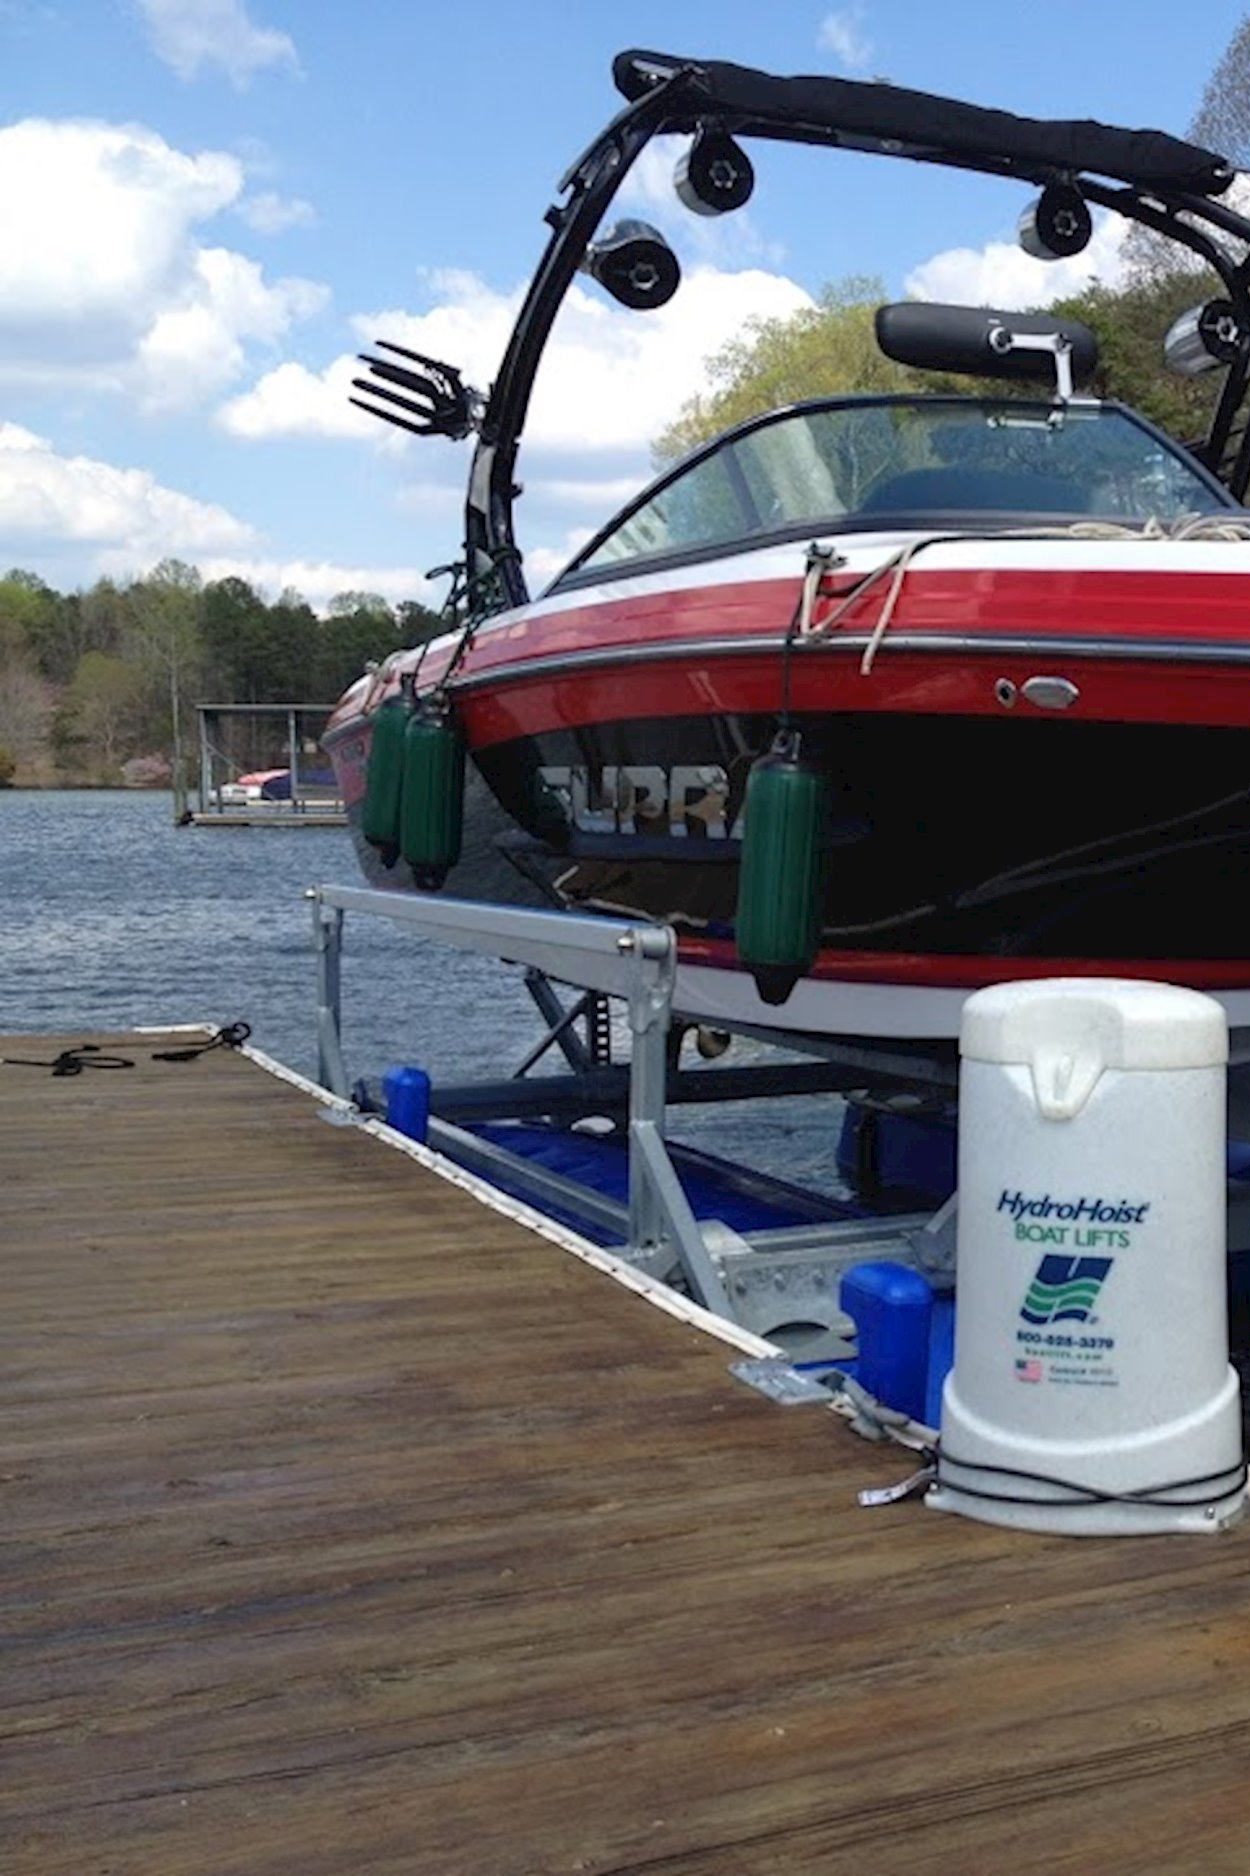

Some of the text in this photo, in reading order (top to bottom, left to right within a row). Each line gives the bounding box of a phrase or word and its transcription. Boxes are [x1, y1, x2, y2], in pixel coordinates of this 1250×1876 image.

[997, 1189, 1149, 1223] HydroHoist
[1015, 1222, 1130, 1248] BOAT LIFTS
